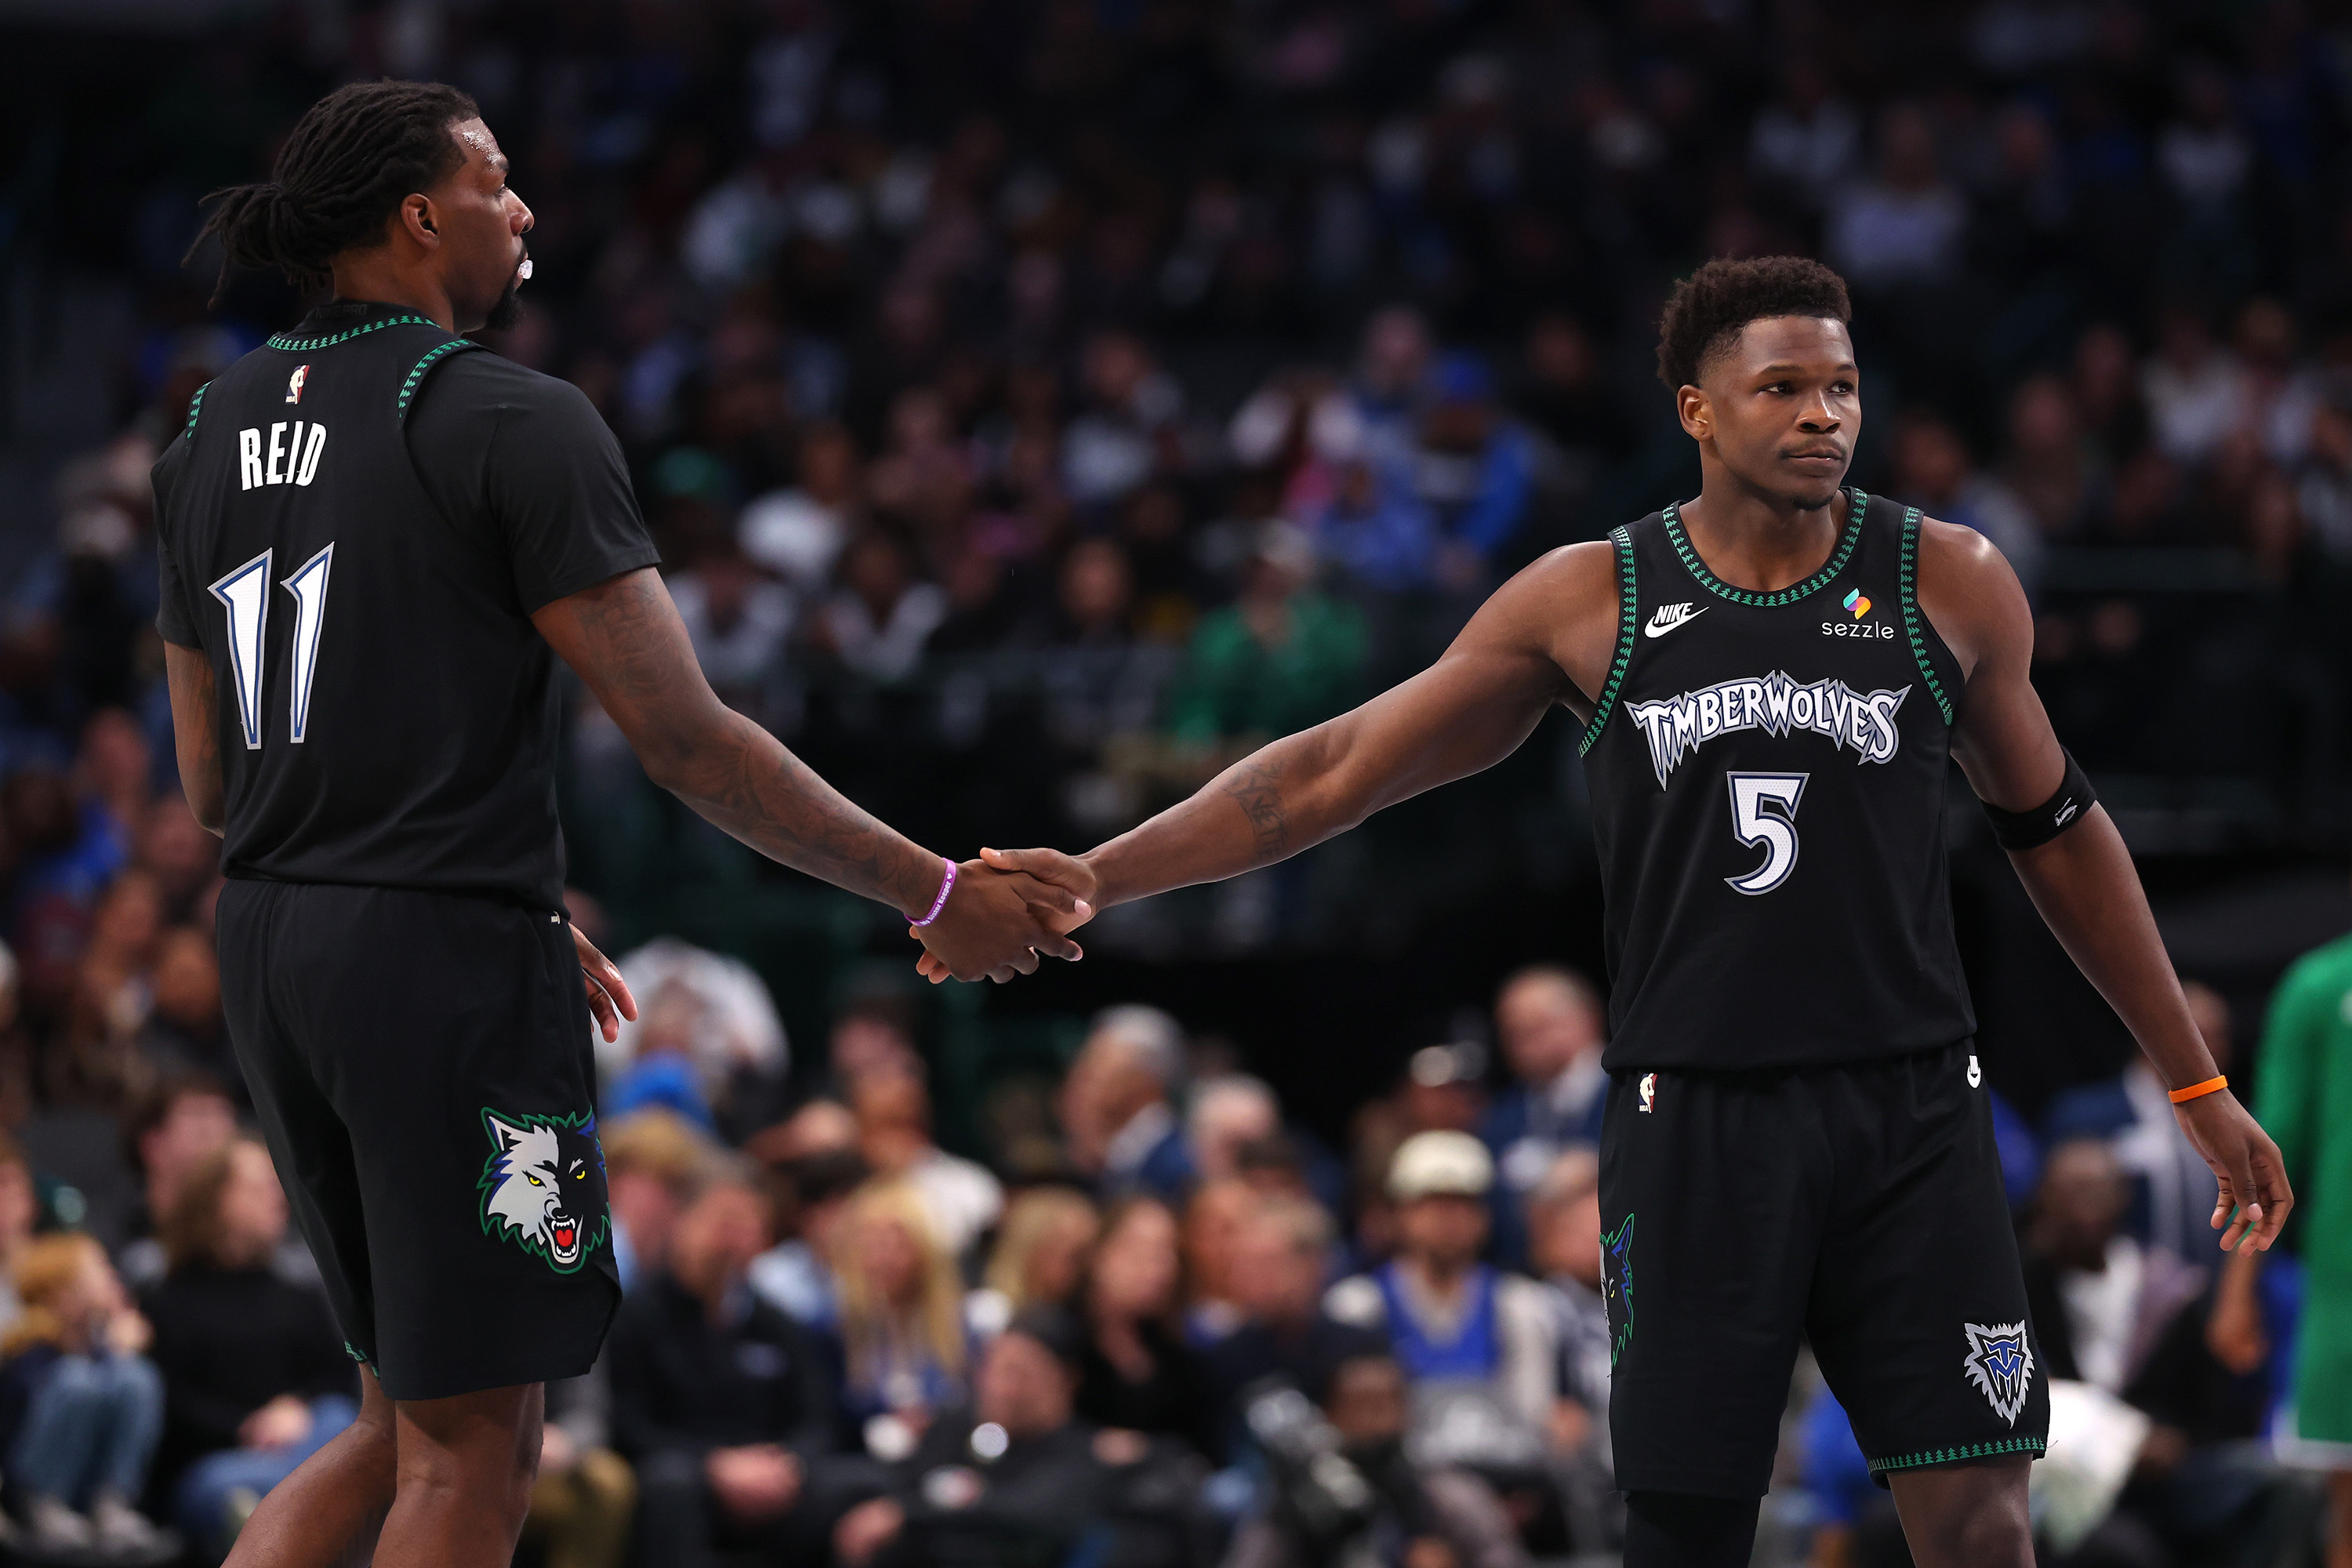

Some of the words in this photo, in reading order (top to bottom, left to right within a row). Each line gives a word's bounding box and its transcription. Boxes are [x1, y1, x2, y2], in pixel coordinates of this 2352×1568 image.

[315, 305, 342, 320] NIKE
[343, 303, 368, 317] PRO
[239, 420, 327, 491] REID
[1653, 602, 1693, 625] NIKE
[1821, 620, 1894, 640] sezzle
[207, 541, 335, 750] 11
[1623, 670, 1913, 792] TIMBERWOLVES
[1724, 771, 1809, 895] 5
[927, 903, 942, 921] Sister
[937, 880, 952, 904] Keeper
